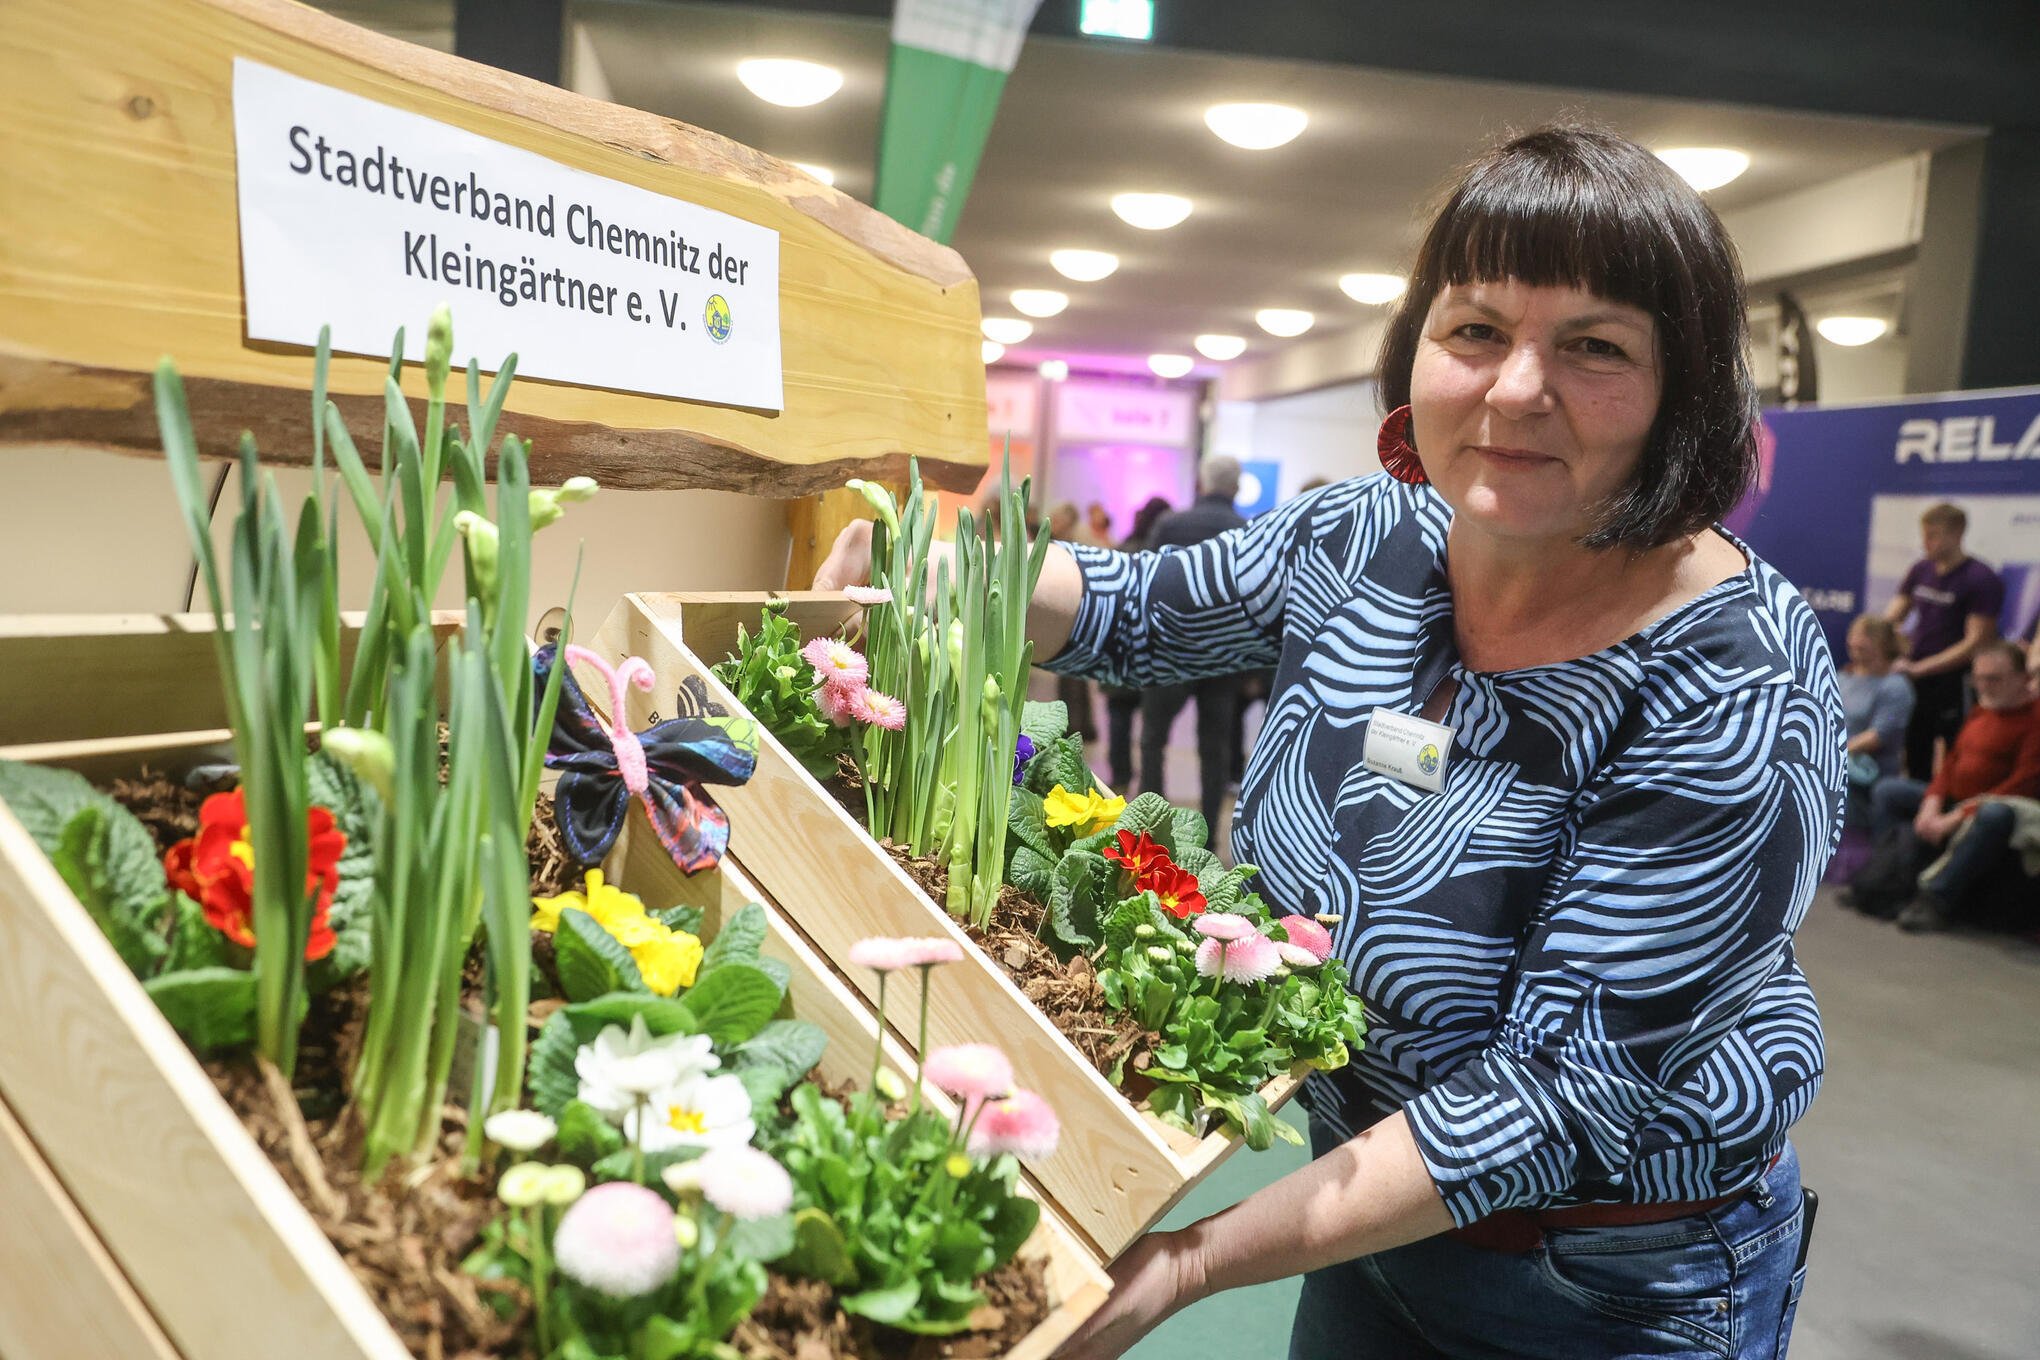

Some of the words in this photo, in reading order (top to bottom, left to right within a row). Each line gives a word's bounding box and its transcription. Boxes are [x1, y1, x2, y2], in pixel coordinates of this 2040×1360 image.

[289, 125, 555, 238] Stadtverband
[566, 203, 700, 275] Chemnitz
[708, 242, 748, 286] der
[404, 230, 617, 316] Kleingärtner
[626, 291, 651, 324] e.
[659, 289, 686, 331] V.
